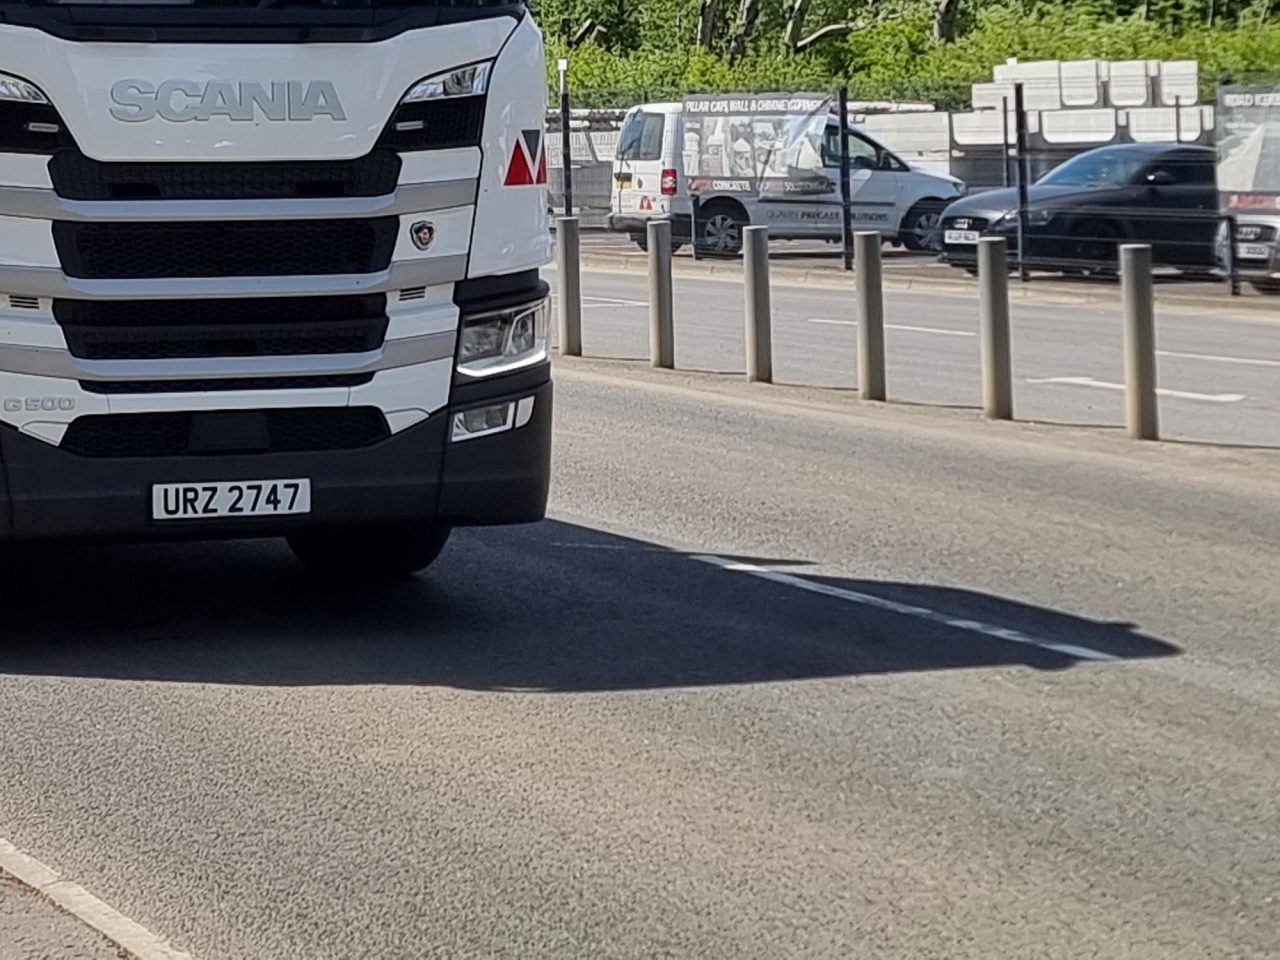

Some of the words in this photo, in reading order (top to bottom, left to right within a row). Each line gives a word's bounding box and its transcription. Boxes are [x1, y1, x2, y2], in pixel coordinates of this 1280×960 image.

[109, 78, 347, 123] SCANIA
[3, 398, 22, 413] G
[25, 397, 76, 412] 500
[163, 486, 219, 516] URZ
[228, 483, 300, 513] 2747
